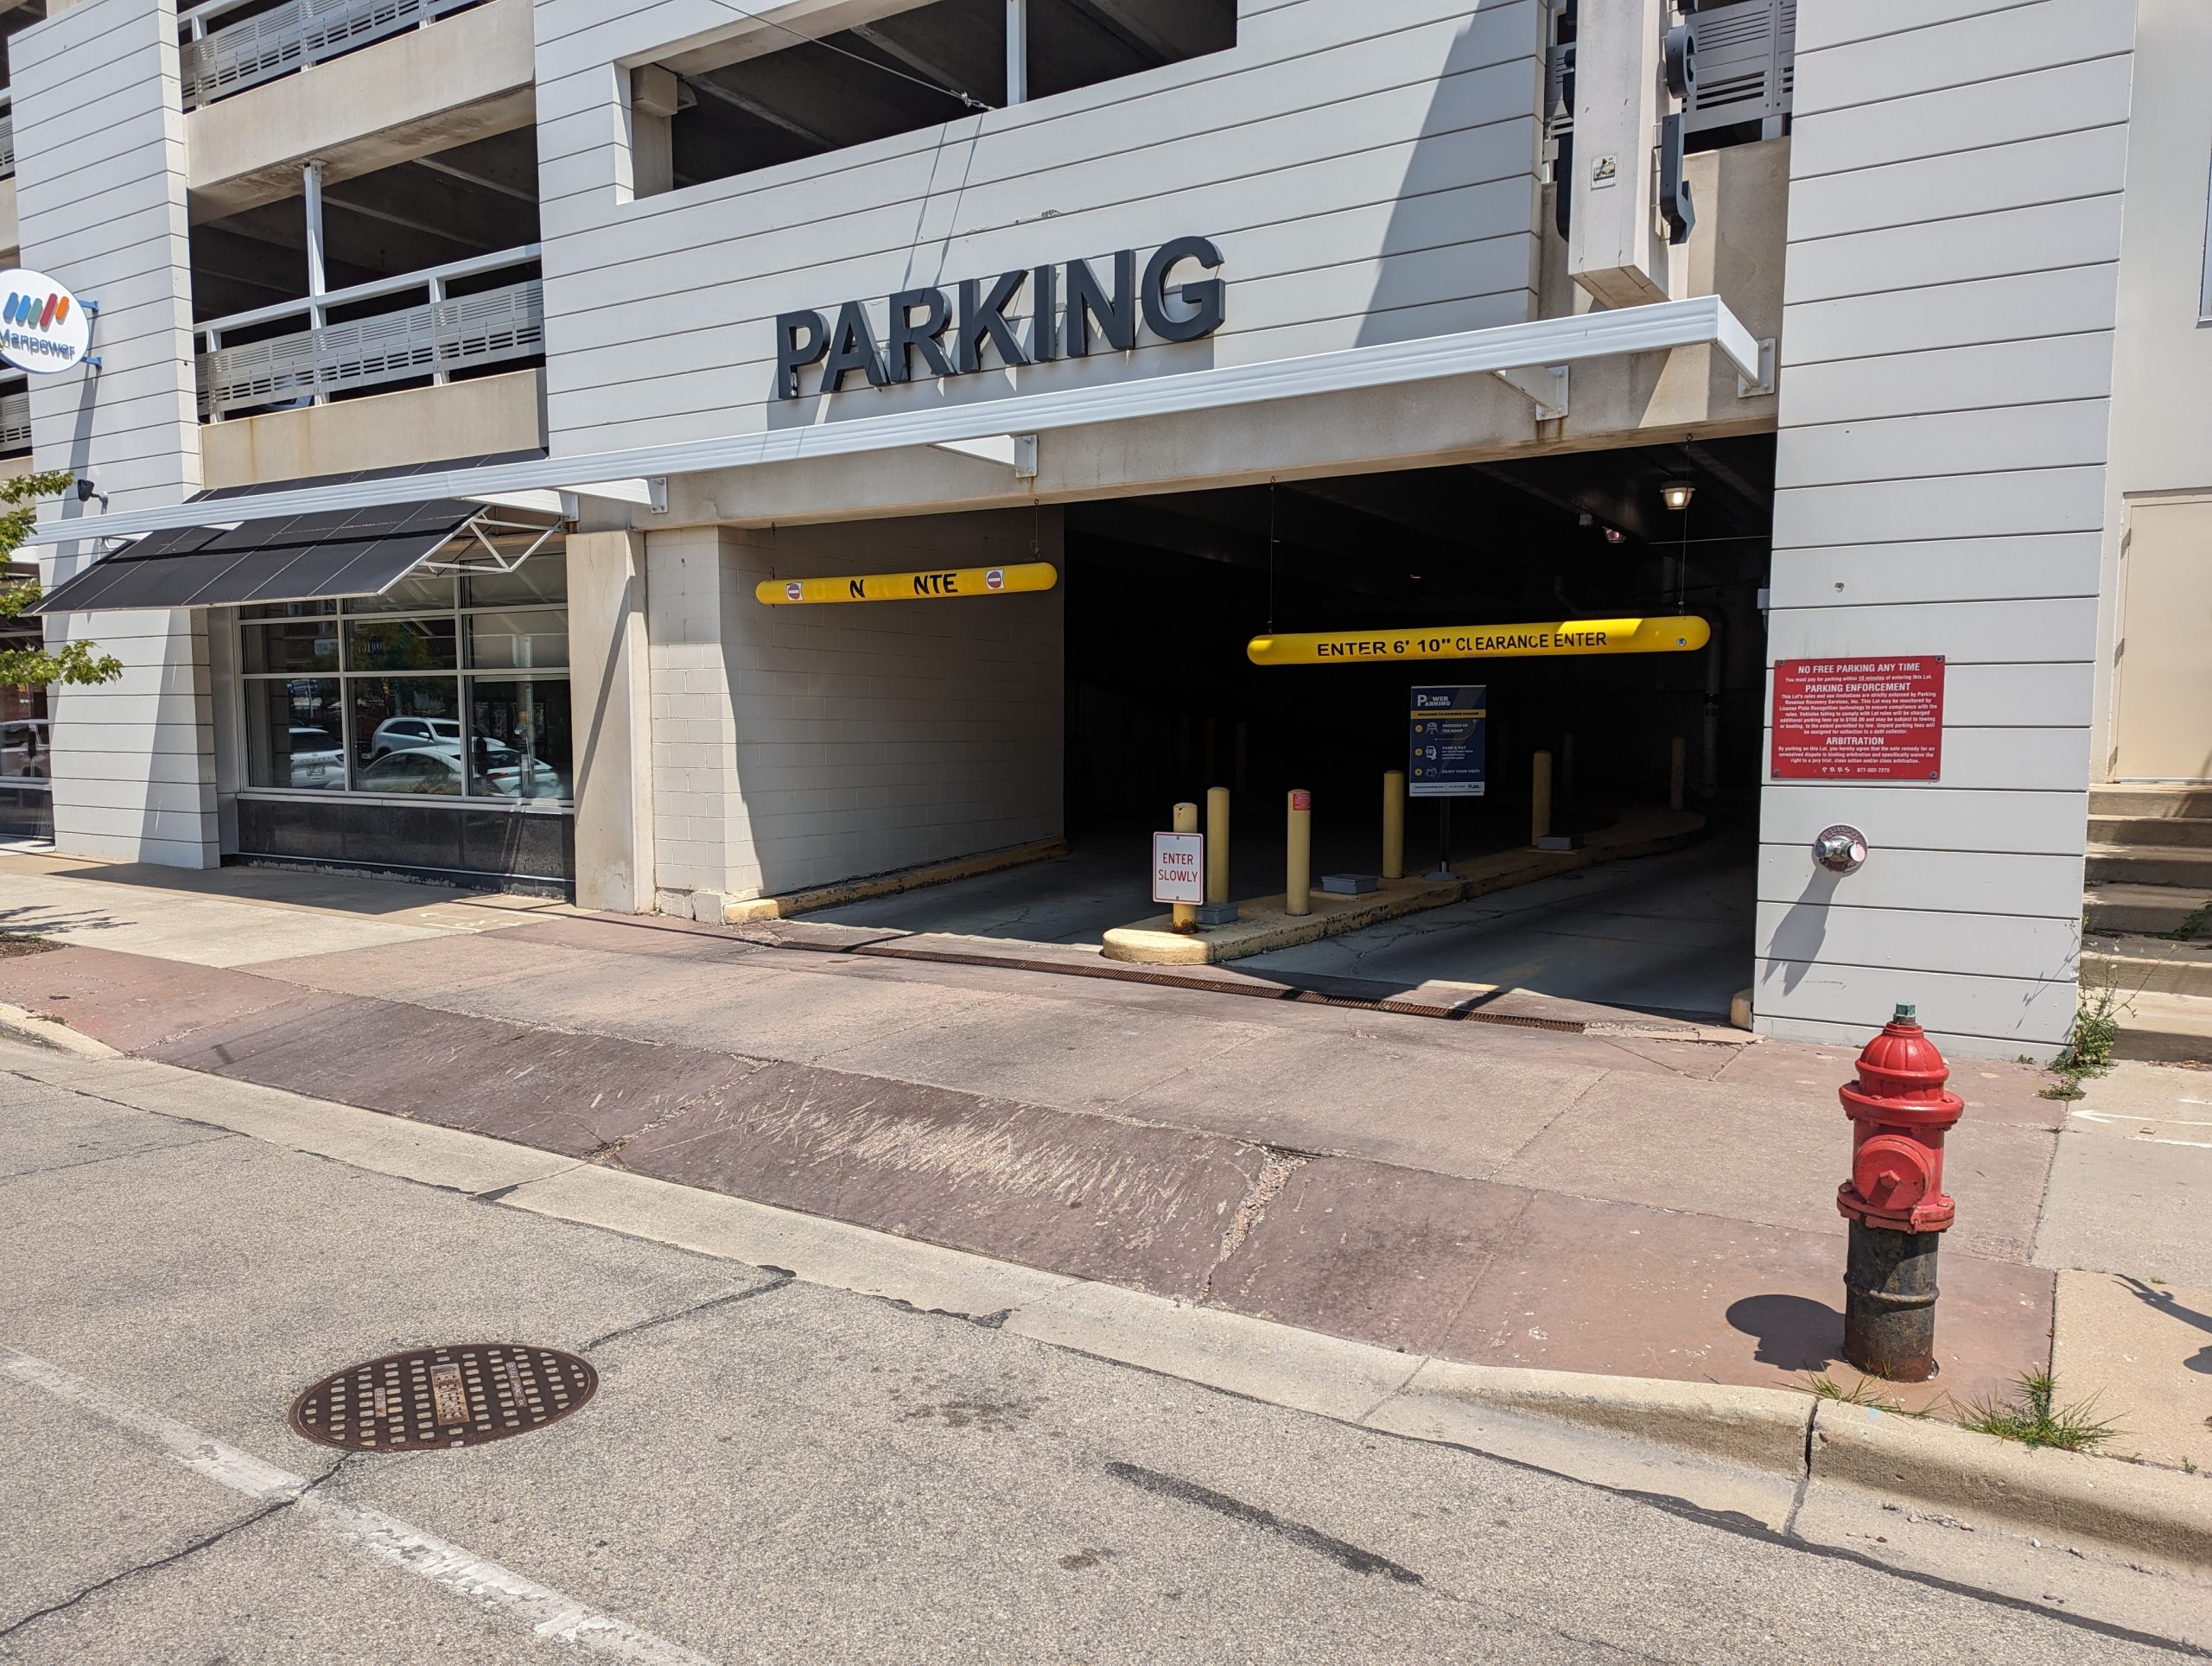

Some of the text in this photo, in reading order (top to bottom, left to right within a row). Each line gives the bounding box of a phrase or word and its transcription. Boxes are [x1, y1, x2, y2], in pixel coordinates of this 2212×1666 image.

[778, 236, 1225, 399] PARKING
[0, 328, 75, 358] Manpower
[1317, 632, 1607, 657] ENTER 6' 10" CLEARANCE ENTER
[1813, 665, 1833, 673] FREE
[1836, 664, 1875, 672] PARKING
[1877, 663, 1895, 671] ANY
[1898, 662, 1919, 671] TIME
[1805, 682, 1910, 692] PARKING ENFORCEMENT
[1826, 736, 1883, 745] ARBITRATION
[1163, 853, 1194, 865] ENTER
[1158, 869, 1198, 883] SLOWLY
